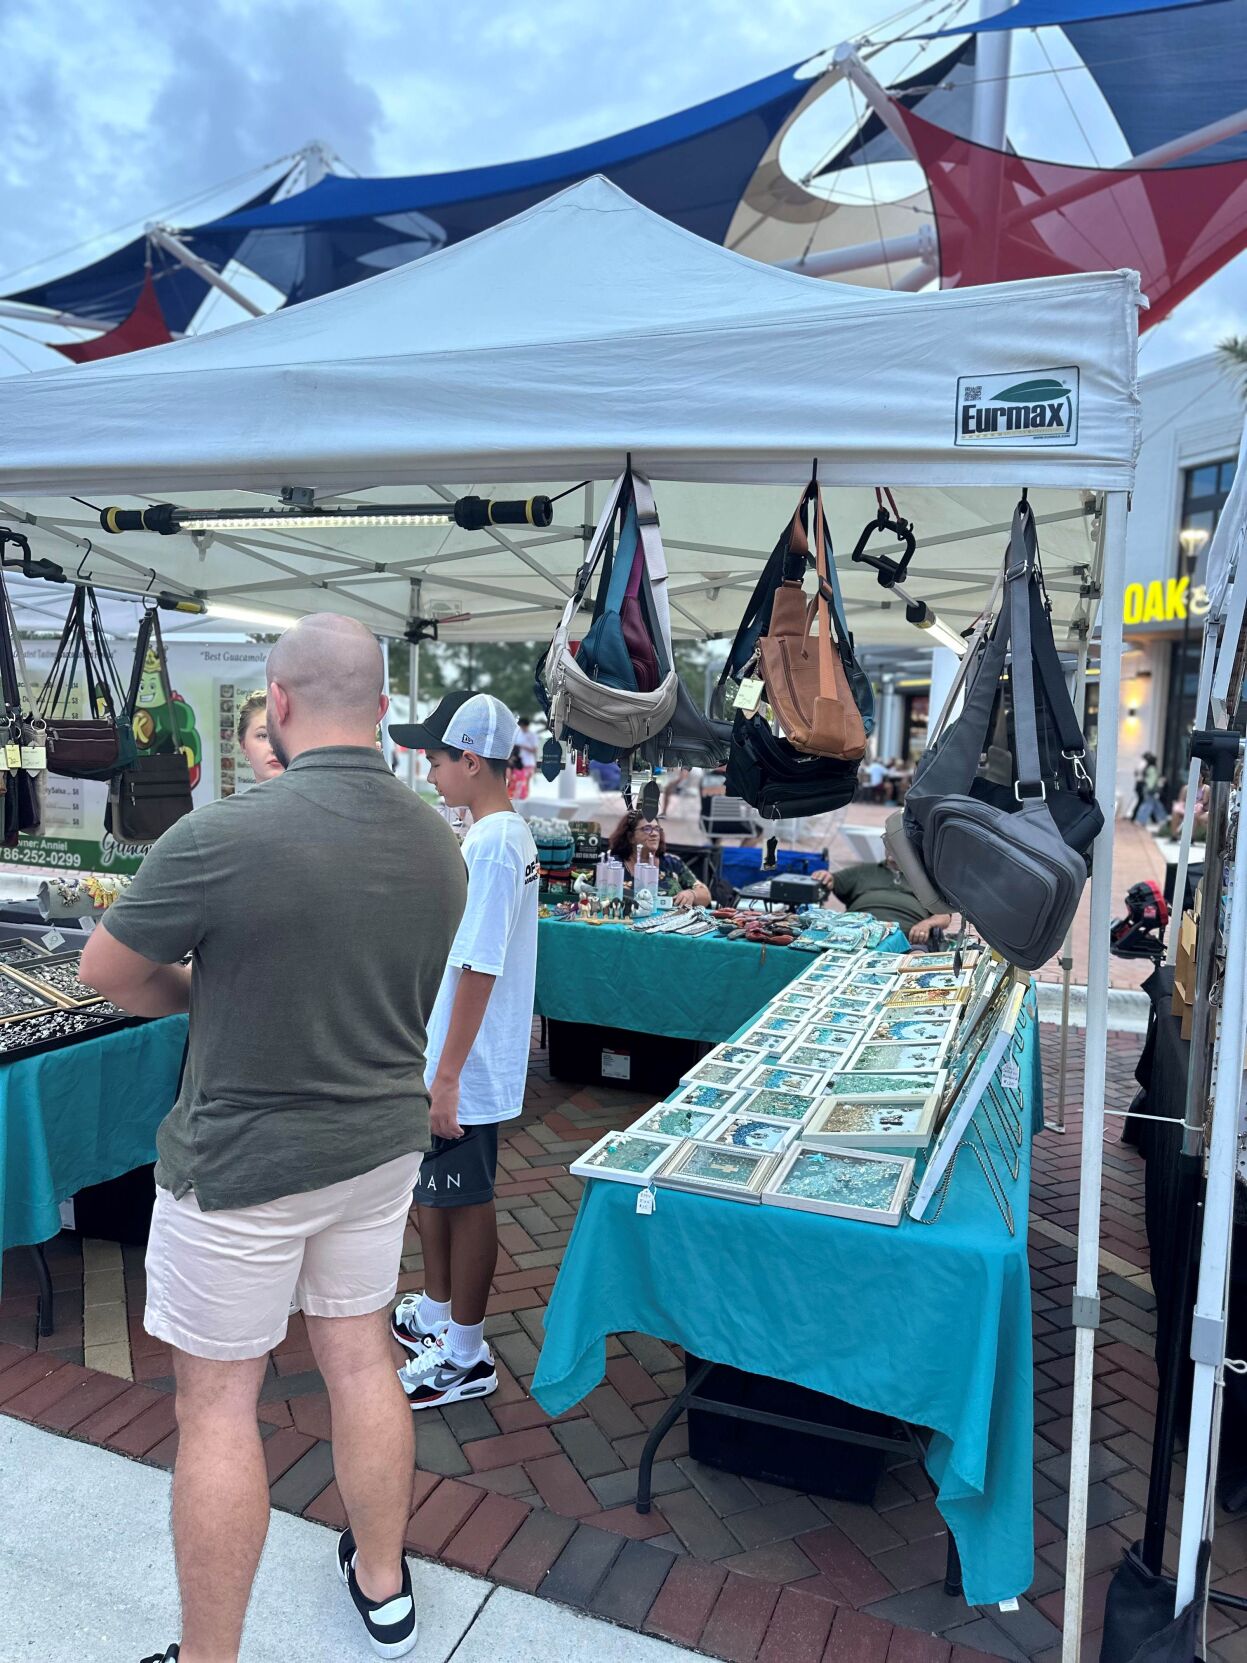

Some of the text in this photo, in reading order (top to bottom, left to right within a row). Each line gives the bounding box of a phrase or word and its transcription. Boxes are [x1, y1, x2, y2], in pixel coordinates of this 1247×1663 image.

[961, 402, 1065, 434] Eurmax
[1123, 576, 1190, 624] OAK
[41, 840, 68, 851] Anniel
